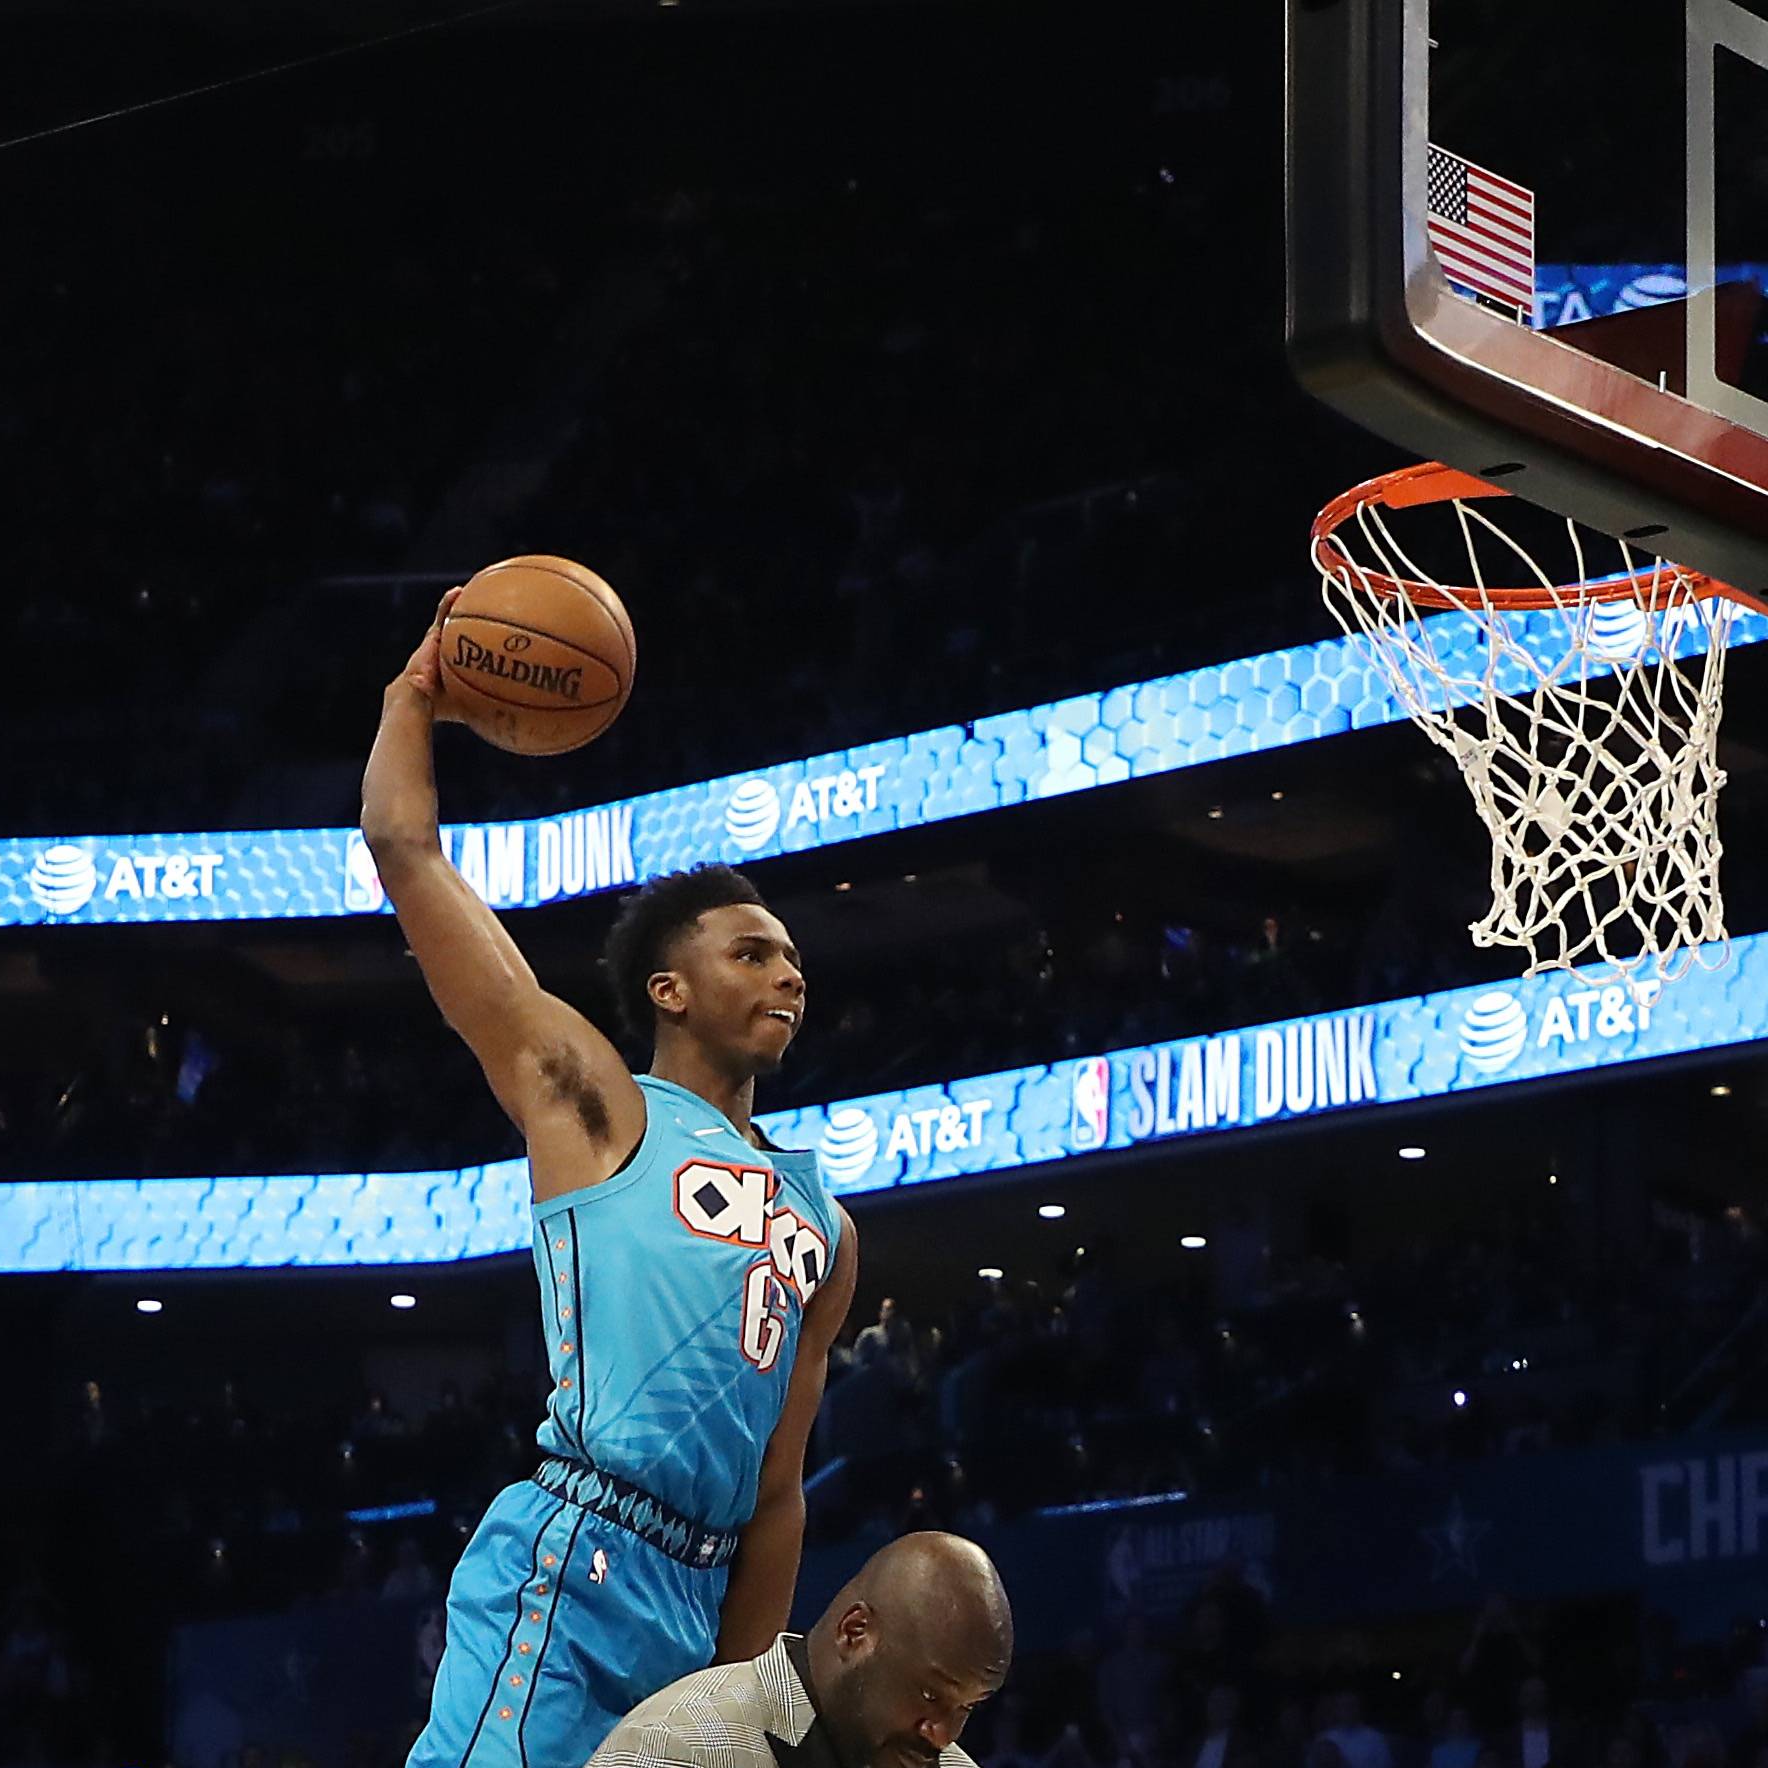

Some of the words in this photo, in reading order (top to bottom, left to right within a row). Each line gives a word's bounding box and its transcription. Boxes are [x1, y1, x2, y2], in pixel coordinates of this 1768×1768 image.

[453, 635, 582, 699] SPALDING
[787, 767, 884, 827] AT&T
[105, 855, 223, 900] AT&T
[538, 807, 634, 901] DUNK
[1537, 979, 1661, 1048] AT&T
[1128, 1035, 1240, 1139] SLAM
[1254, 1013, 1377, 1119] DUNK
[885, 1099, 992, 1161] AT&T
[743, 1264, 787, 1371] 6
